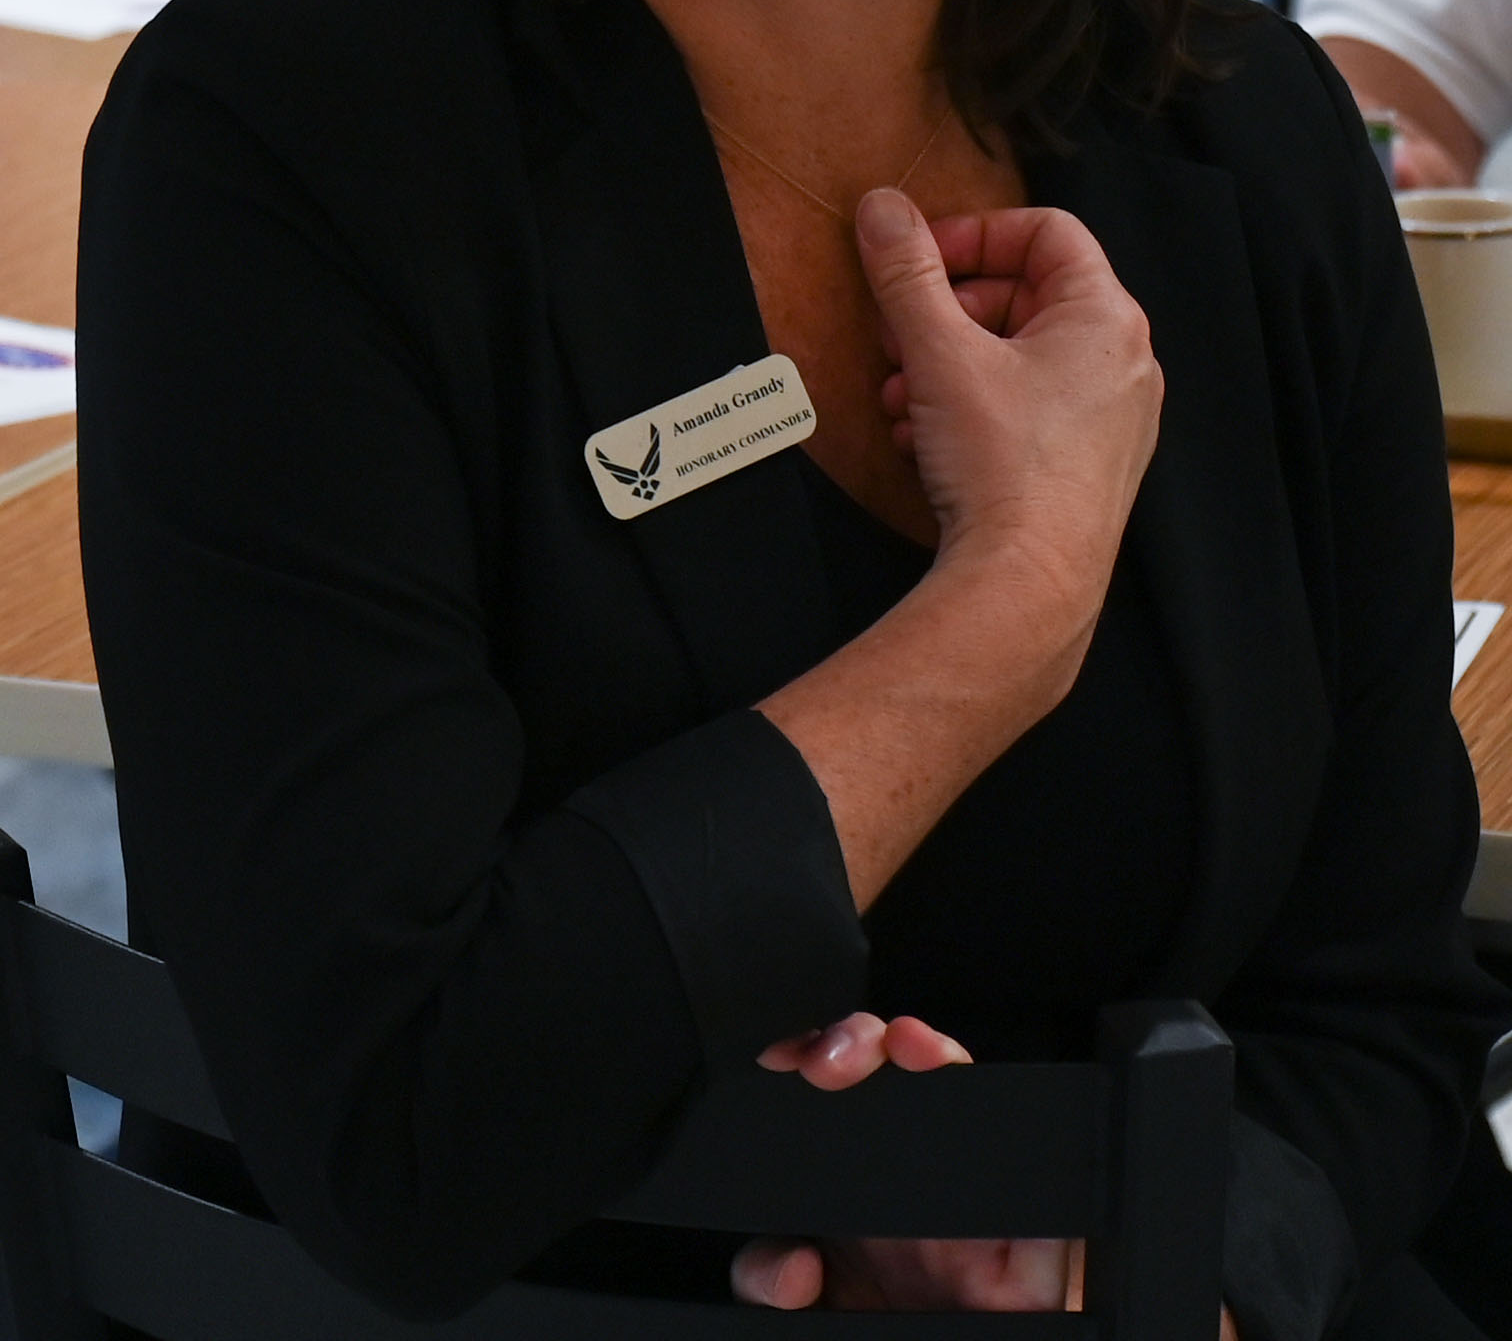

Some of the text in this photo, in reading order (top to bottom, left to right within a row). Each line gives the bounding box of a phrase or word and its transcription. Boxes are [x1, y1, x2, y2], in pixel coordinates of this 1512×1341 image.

[673, 377, 785, 437] Amanda Grandy
[676, 408, 812, 477] HONORARY COMMANDER
